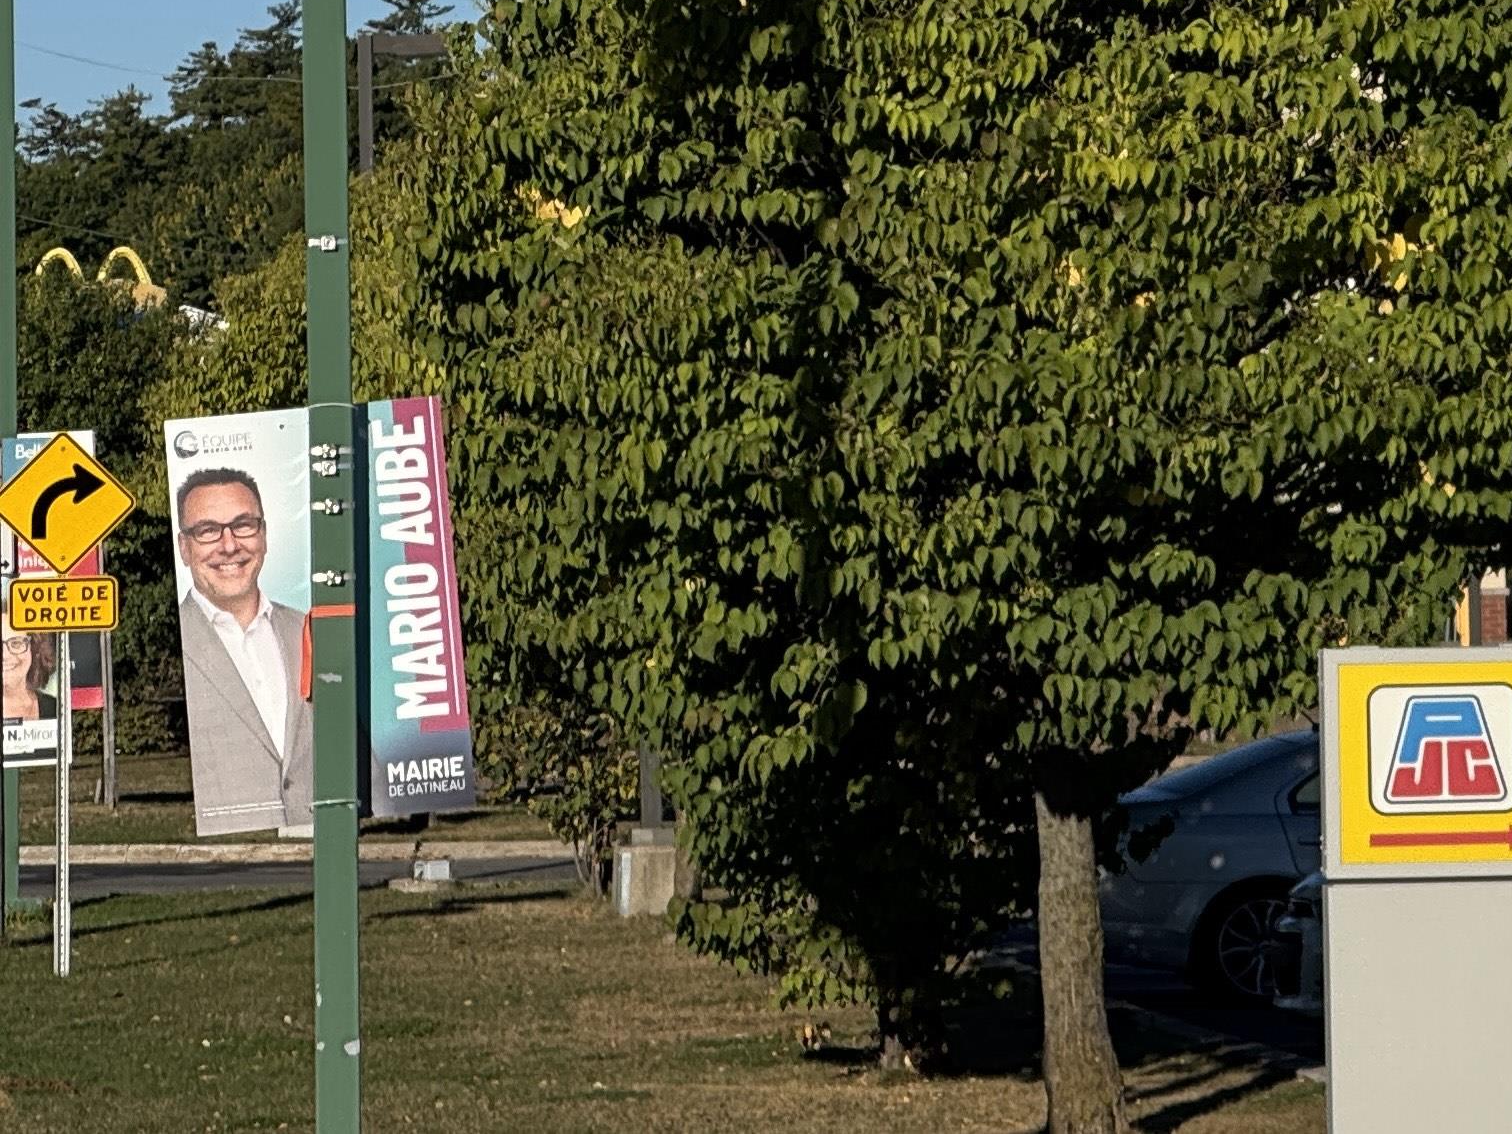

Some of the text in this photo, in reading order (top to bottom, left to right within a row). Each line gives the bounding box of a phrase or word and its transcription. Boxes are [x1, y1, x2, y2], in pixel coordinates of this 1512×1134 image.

[18, 585, 108, 603] VOIE DE
[25, 606, 101, 623] DROITE
[384, 561, 450, 720] MARIO
[387, 755, 466, 784] MAIRIE
[388, 777, 466, 798] DE GATINEAU
